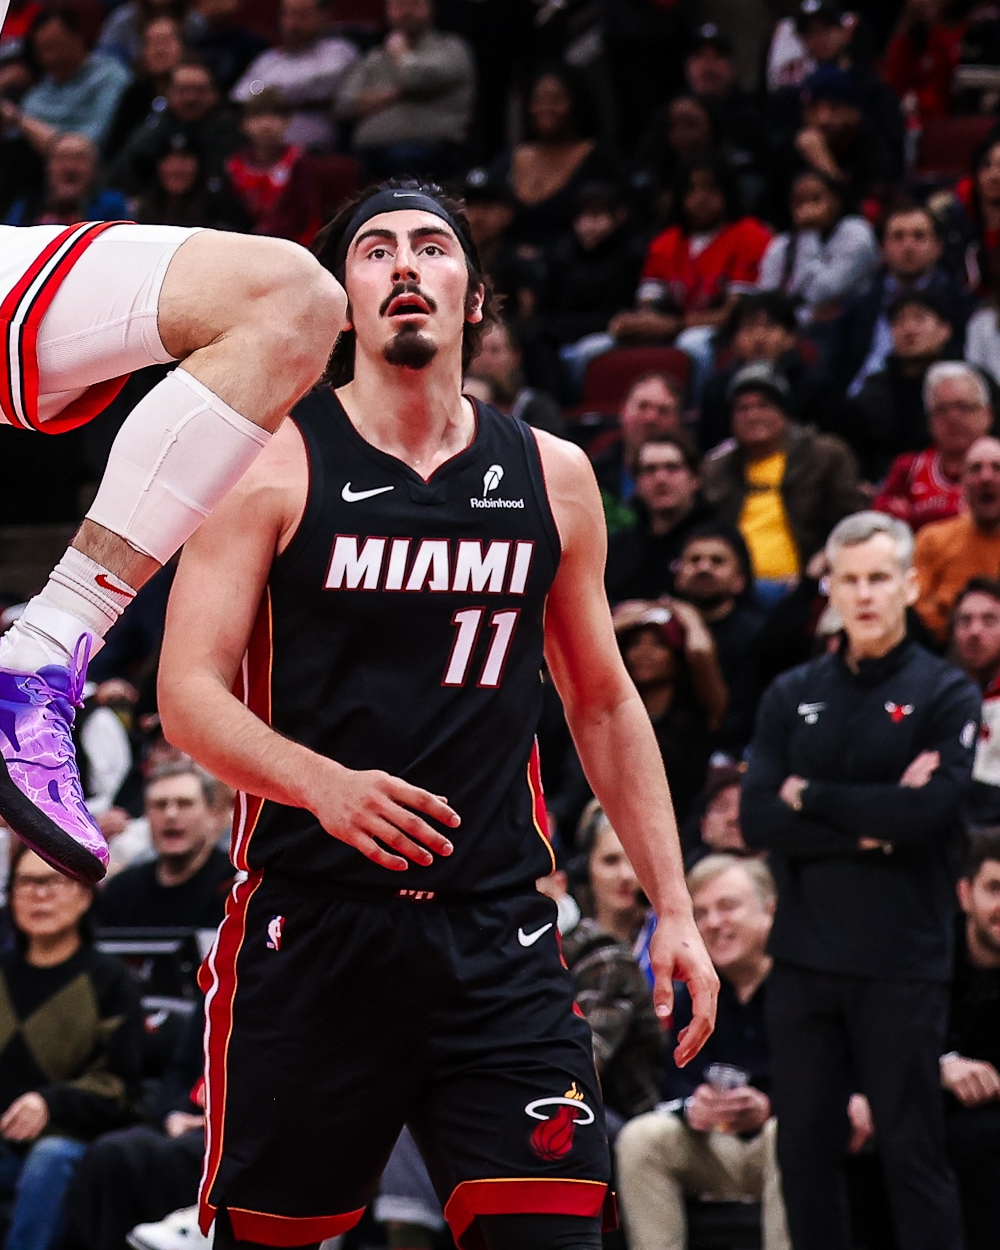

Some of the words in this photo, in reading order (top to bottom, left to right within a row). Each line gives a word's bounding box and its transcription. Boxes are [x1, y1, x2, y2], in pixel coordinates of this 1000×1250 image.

[469, 497, 525, 509] Robinhood
[322, 534, 535, 595] MIAMI
[441, 606, 521, 688] 11
